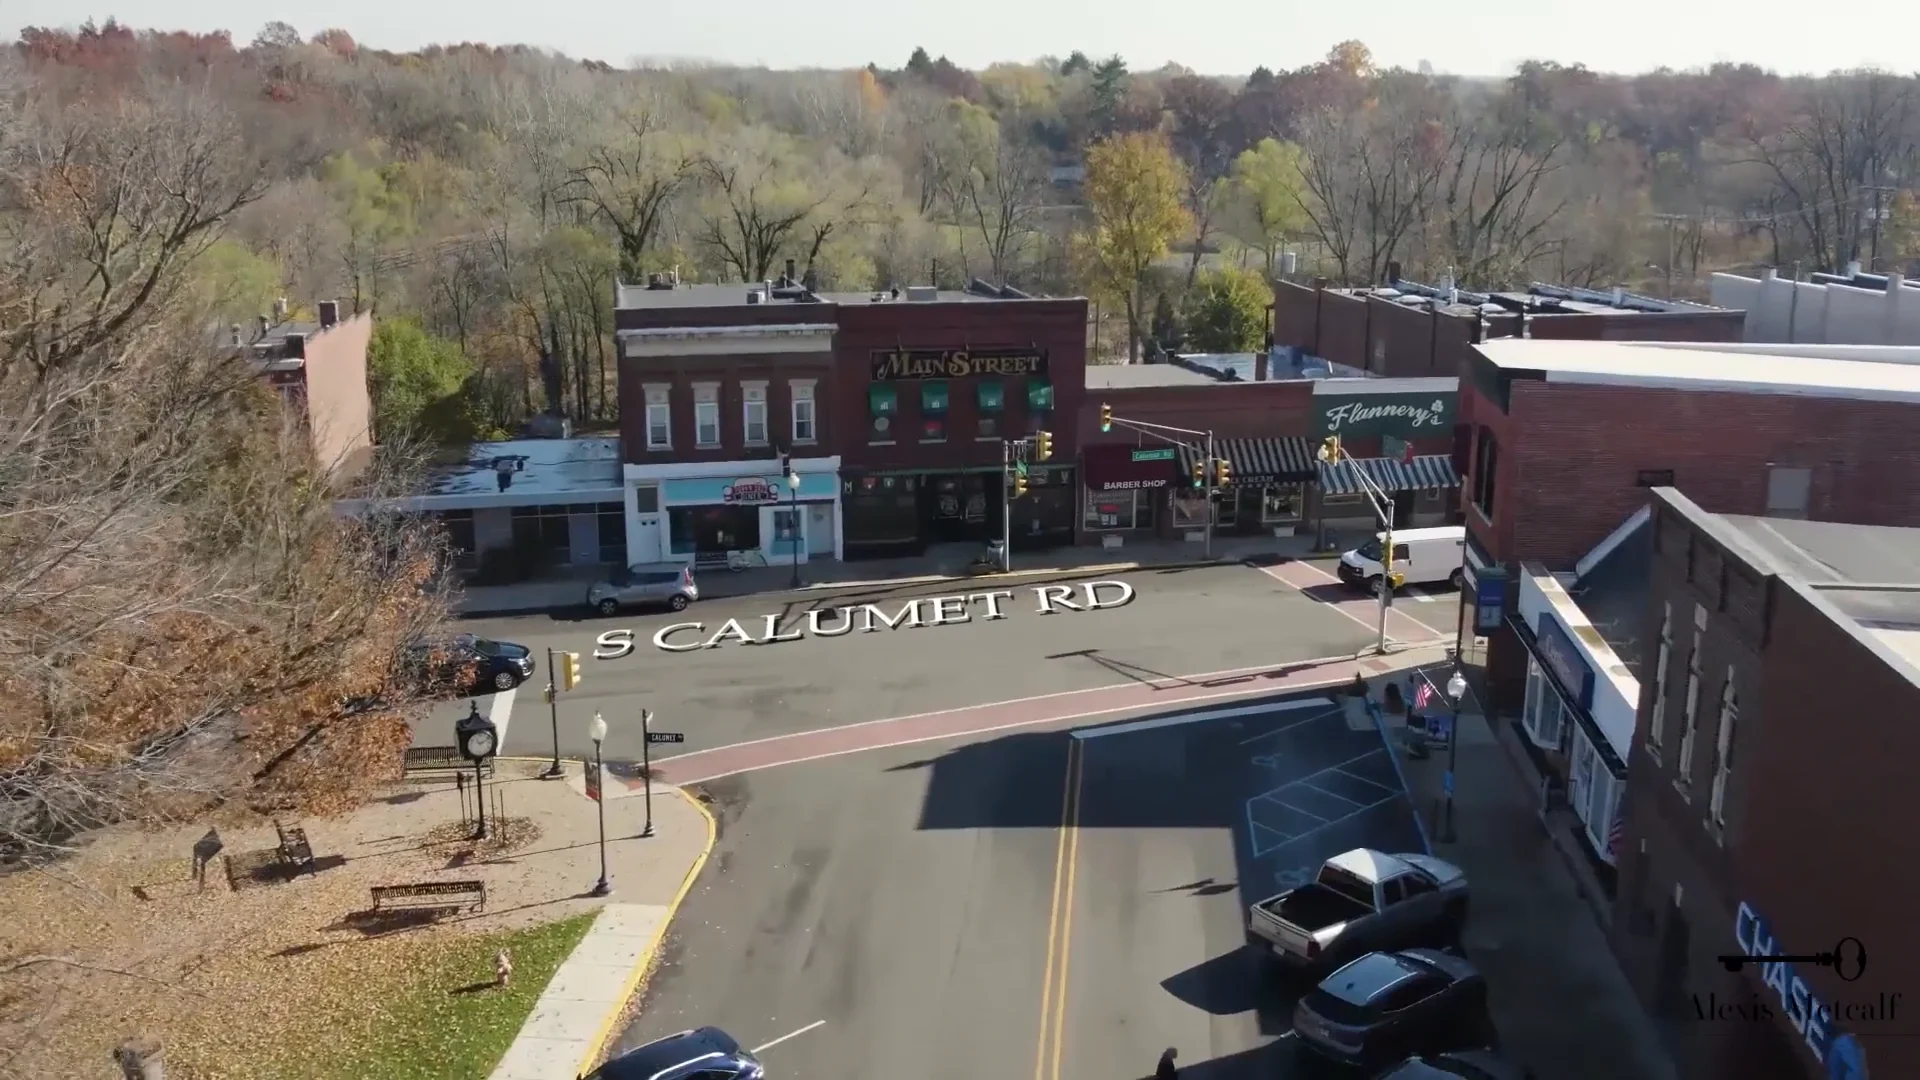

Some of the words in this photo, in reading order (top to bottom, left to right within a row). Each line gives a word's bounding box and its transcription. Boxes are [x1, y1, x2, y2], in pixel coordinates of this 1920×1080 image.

[1326, 402, 1443, 431] Flannery's
[1103, 480, 1140, 490] BARBER
[1142, 479, 1166, 488] SHOP
[1736, 901, 1829, 1064] CHASE
